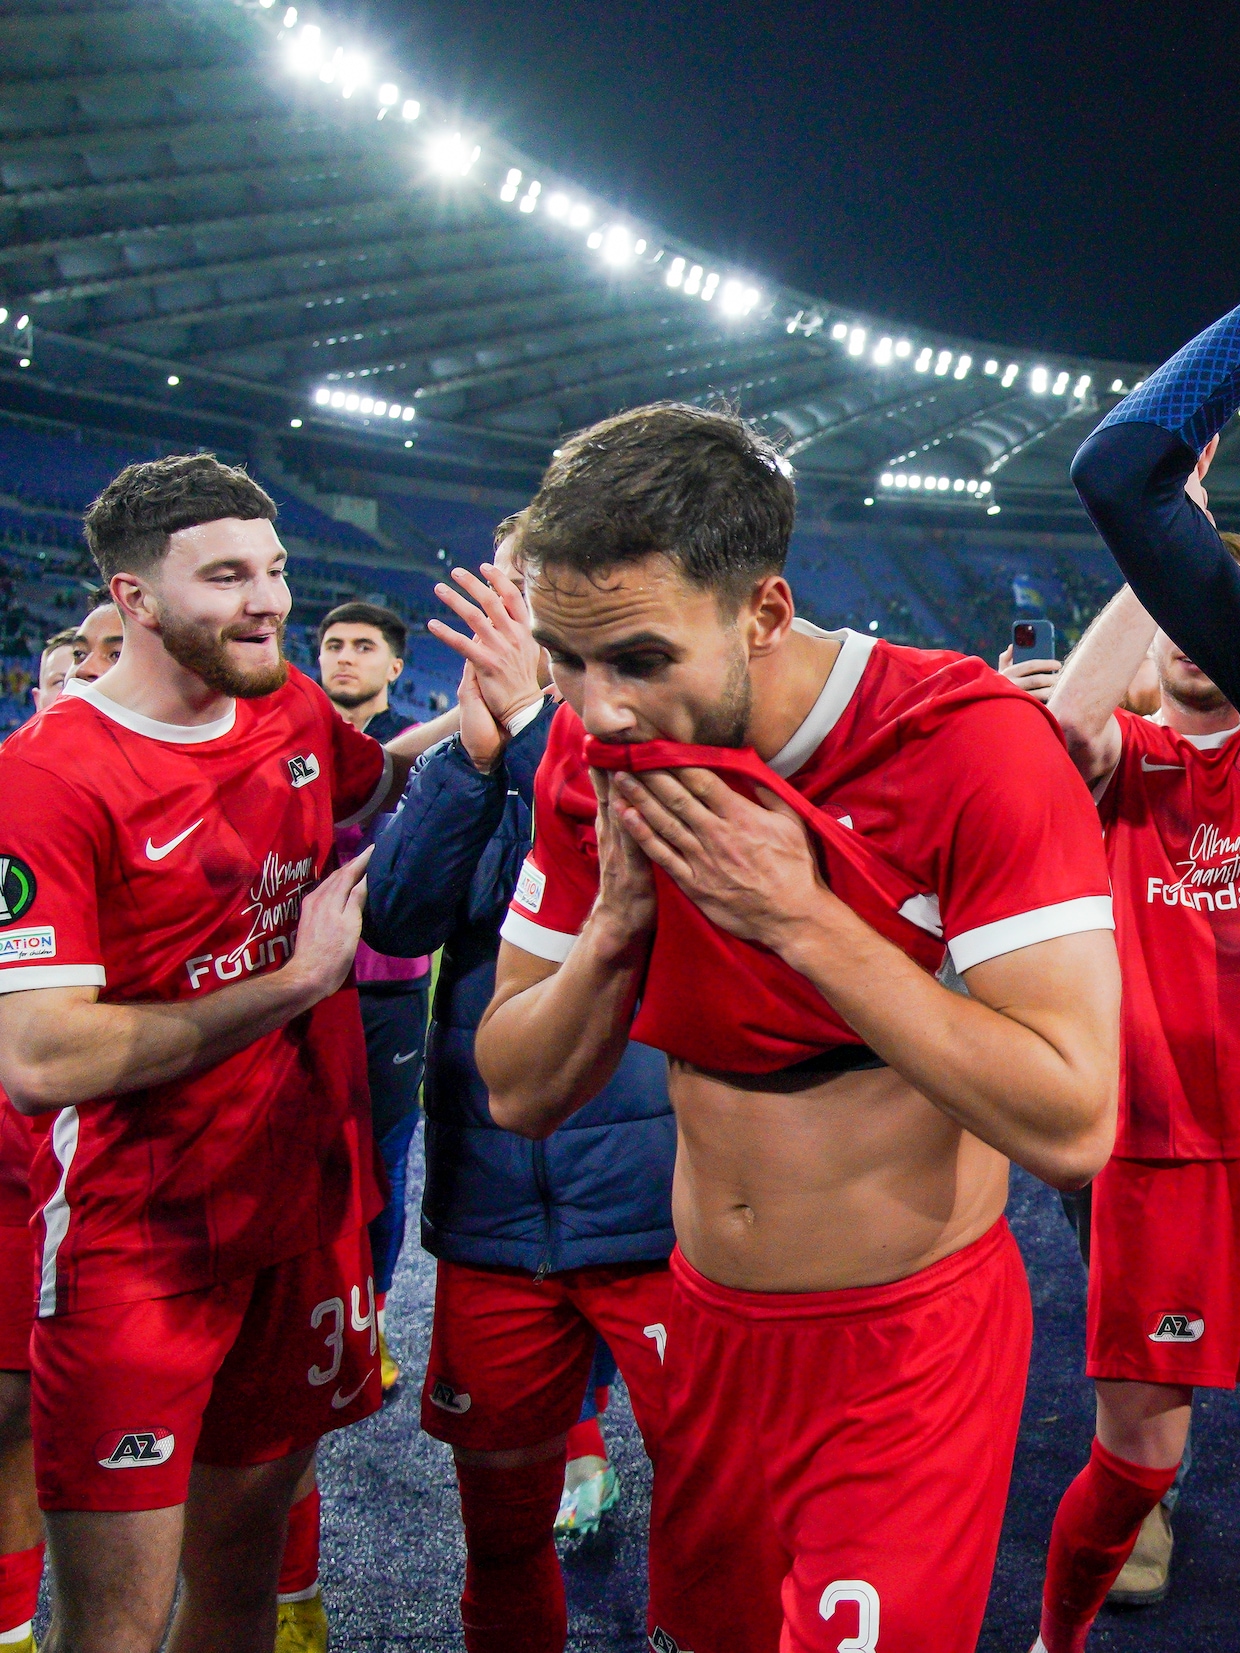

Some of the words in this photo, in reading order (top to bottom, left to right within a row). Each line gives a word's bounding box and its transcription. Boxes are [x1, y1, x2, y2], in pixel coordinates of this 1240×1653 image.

[288, 755, 316, 783] AZ
[307, 1274, 378, 1387] 34
[1155, 1314, 1196, 1338] AZ
[108, 1432, 164, 1464] AZ
